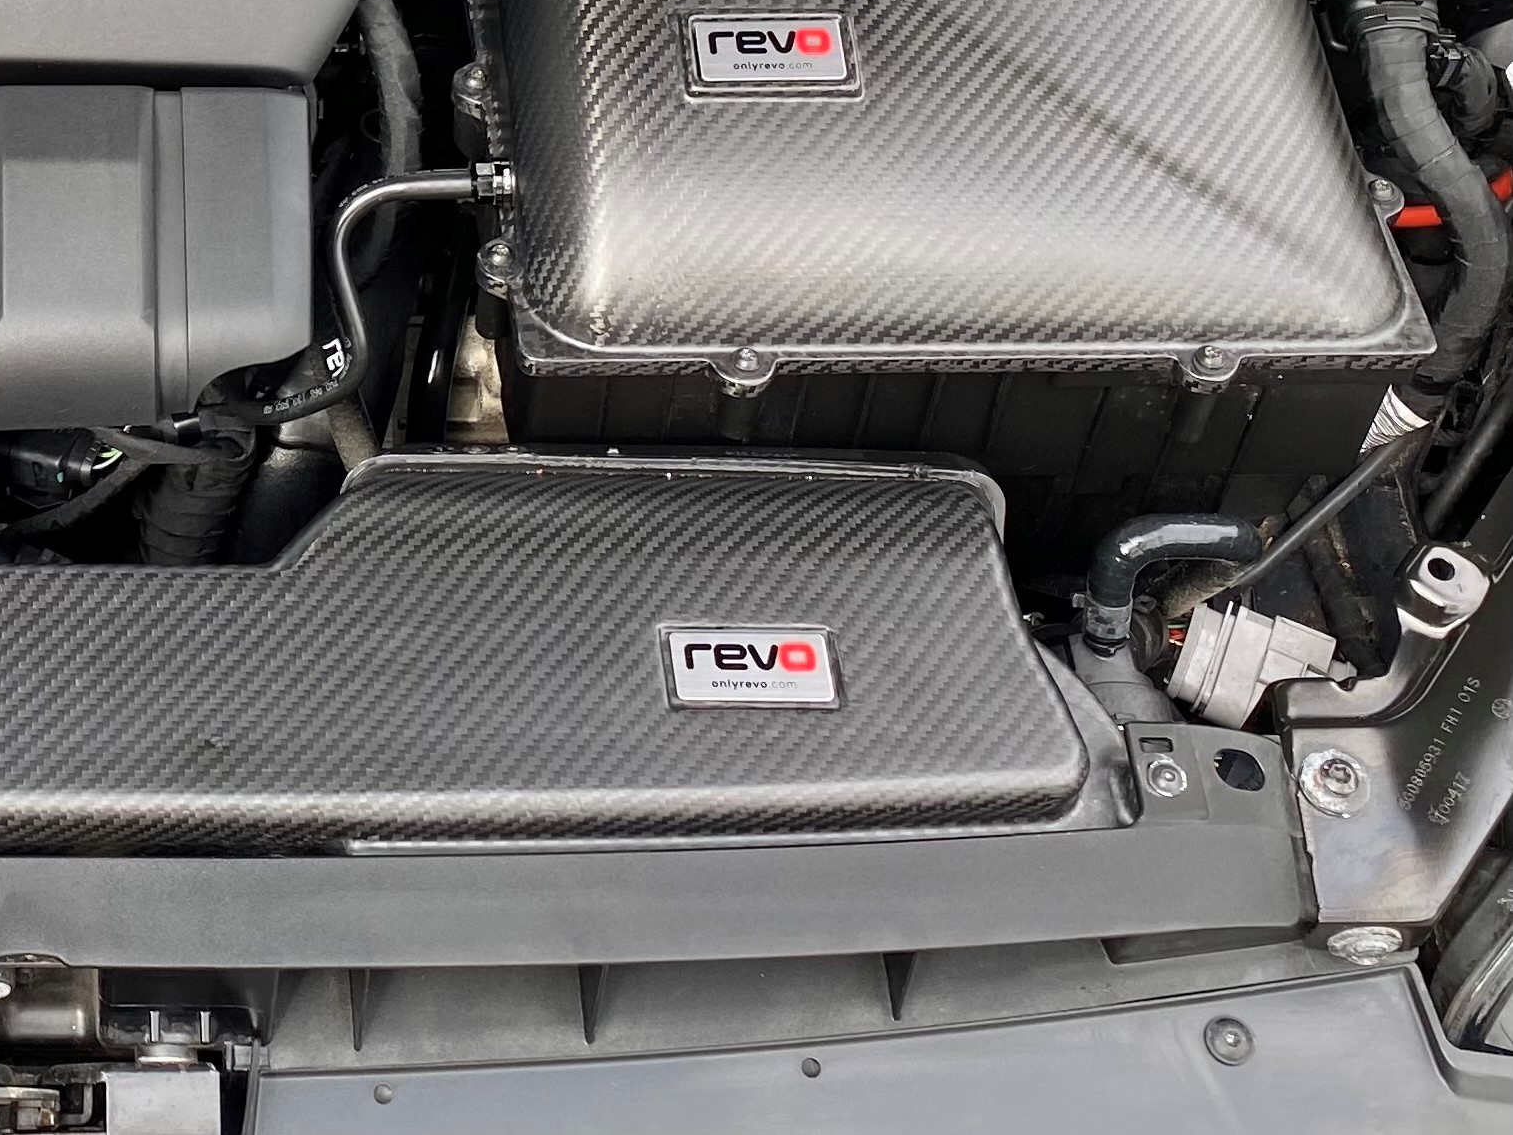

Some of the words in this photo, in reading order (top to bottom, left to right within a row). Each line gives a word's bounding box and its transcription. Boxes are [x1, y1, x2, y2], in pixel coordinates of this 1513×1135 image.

[708, 27, 831, 55] revo
[733, 61, 813, 72] onlyrevo.com
[684, 642, 817, 672] revo
[711, 679, 798, 690] onlyrevo.com
